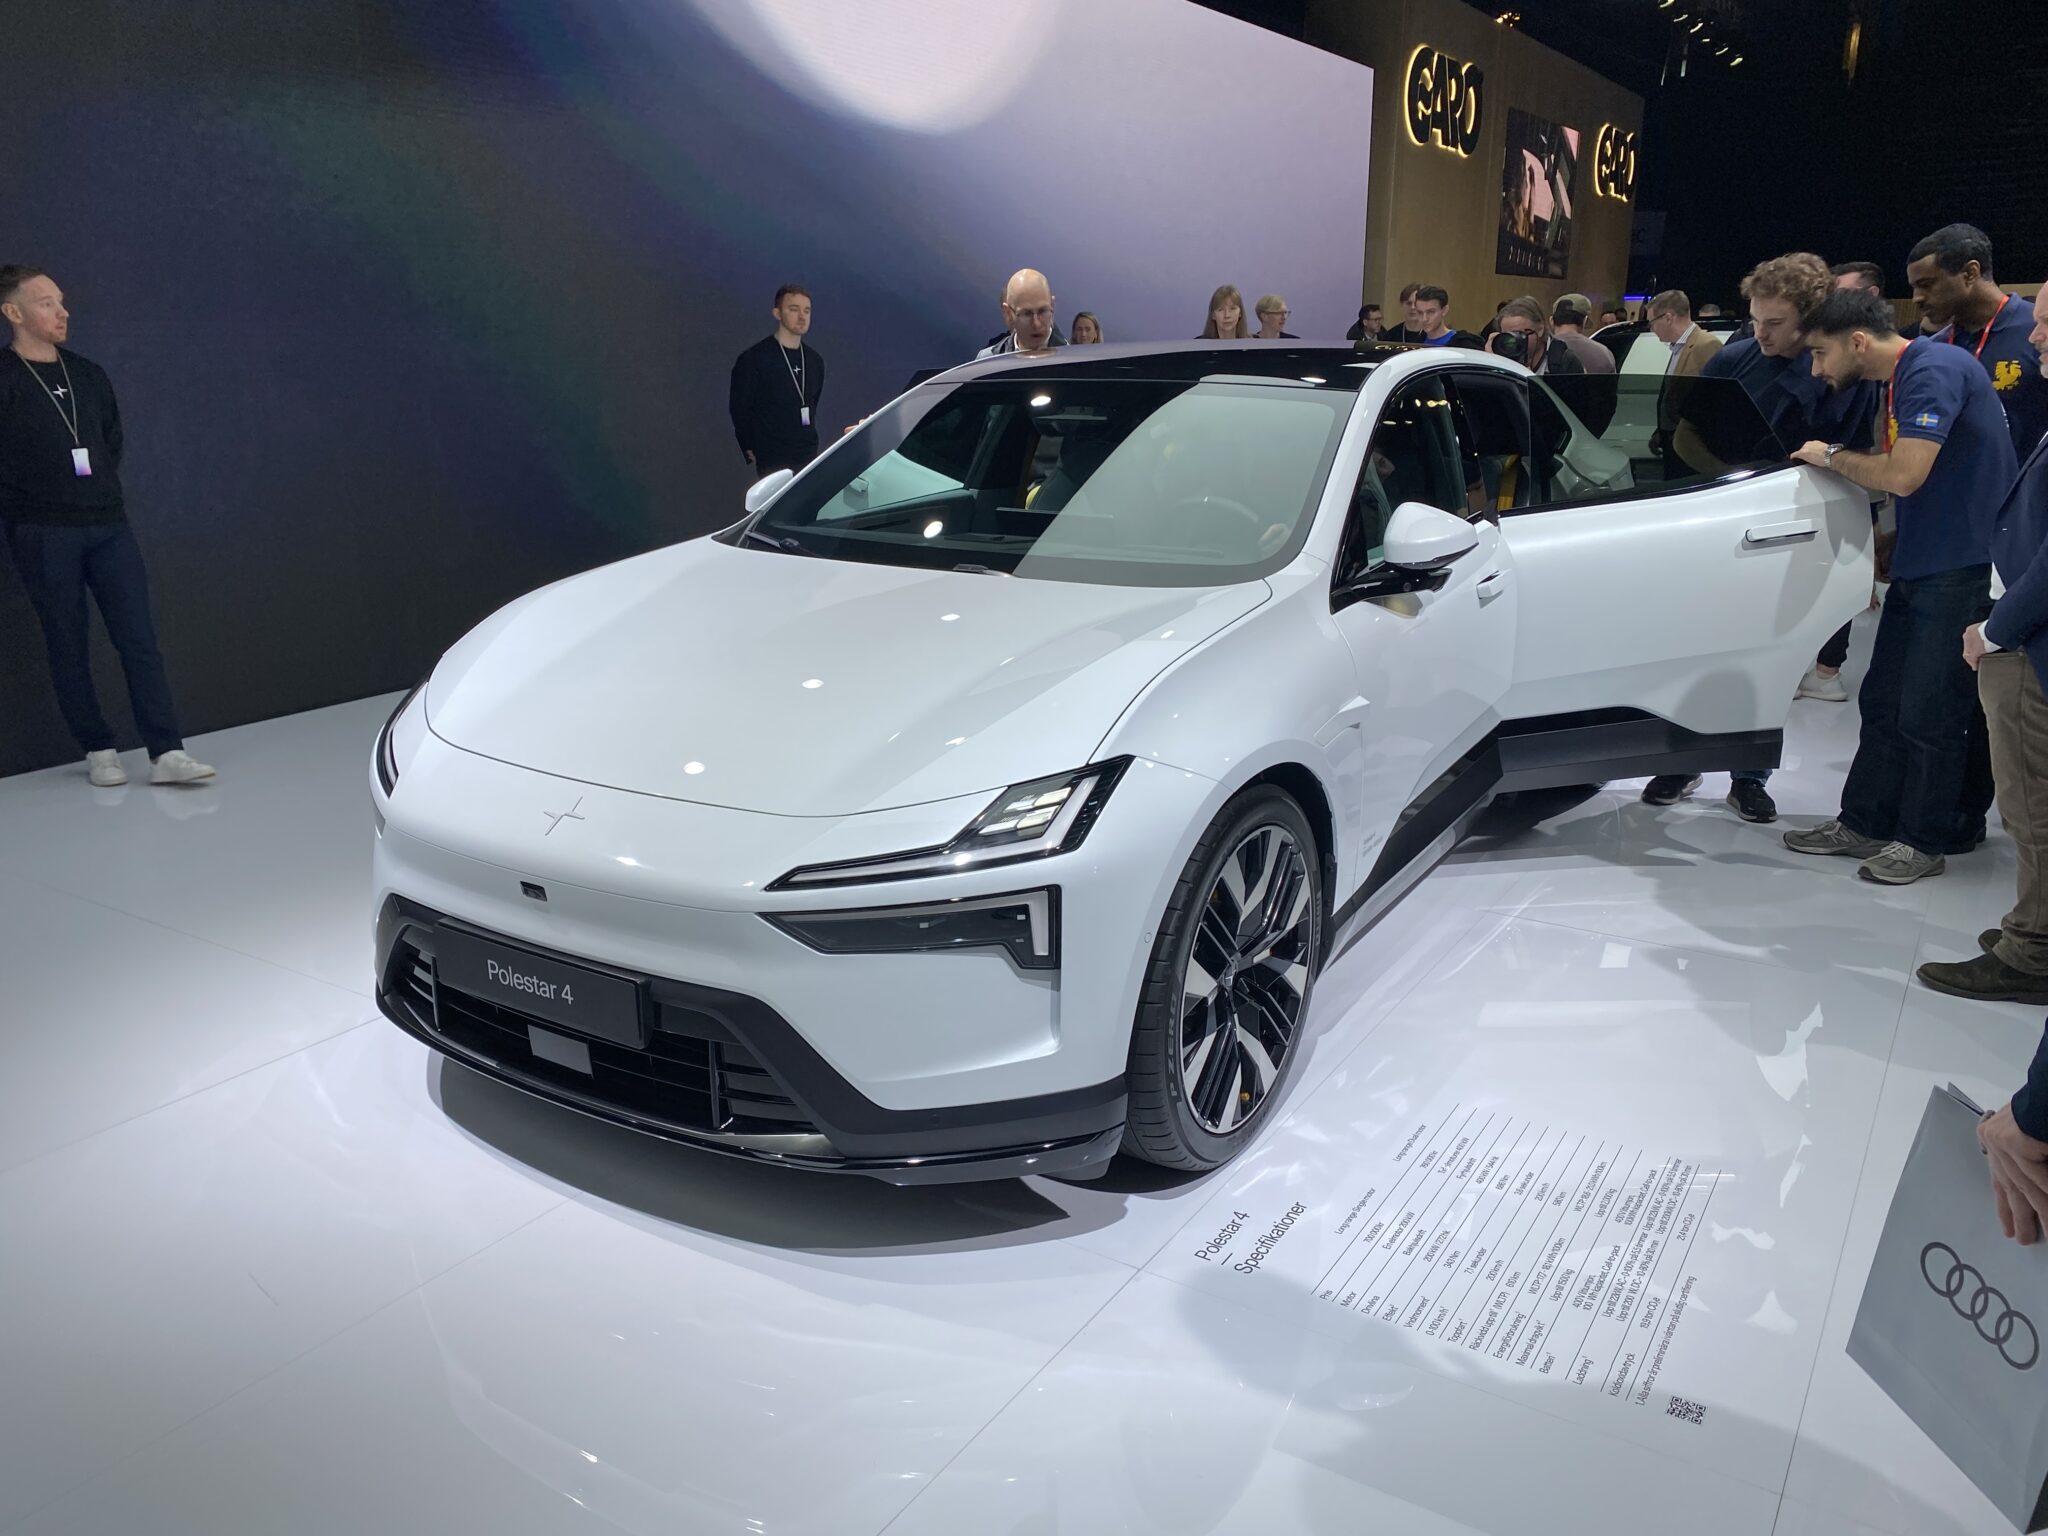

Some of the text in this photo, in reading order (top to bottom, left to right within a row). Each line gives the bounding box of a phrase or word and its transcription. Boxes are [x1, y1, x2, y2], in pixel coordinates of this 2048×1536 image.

[1405, 44, 1484, 157] GARO
[487, 959, 574, 1005] Polestar 4
[1352, 1200, 1367, 1212] Single
[1194, 1219, 1242, 1261] Polestar
[1234, 1202, 1307, 1274] Specifikationer
[1402, 1229, 1427, 1256] Bakhjulsdrift
[1443, 1258, 1455, 1268] 343
[1470, 1247, 1487, 1269] sekunder
[1320, 1290, 1333, 1300] Pris
[1340, 1291, 1357, 1307] Motor
[1361, 1296, 1380, 1314] Drivlina
[1425, 1321, 1441, 1335] 0-100
[1515, 1342, 1534, 1366] Maximal
